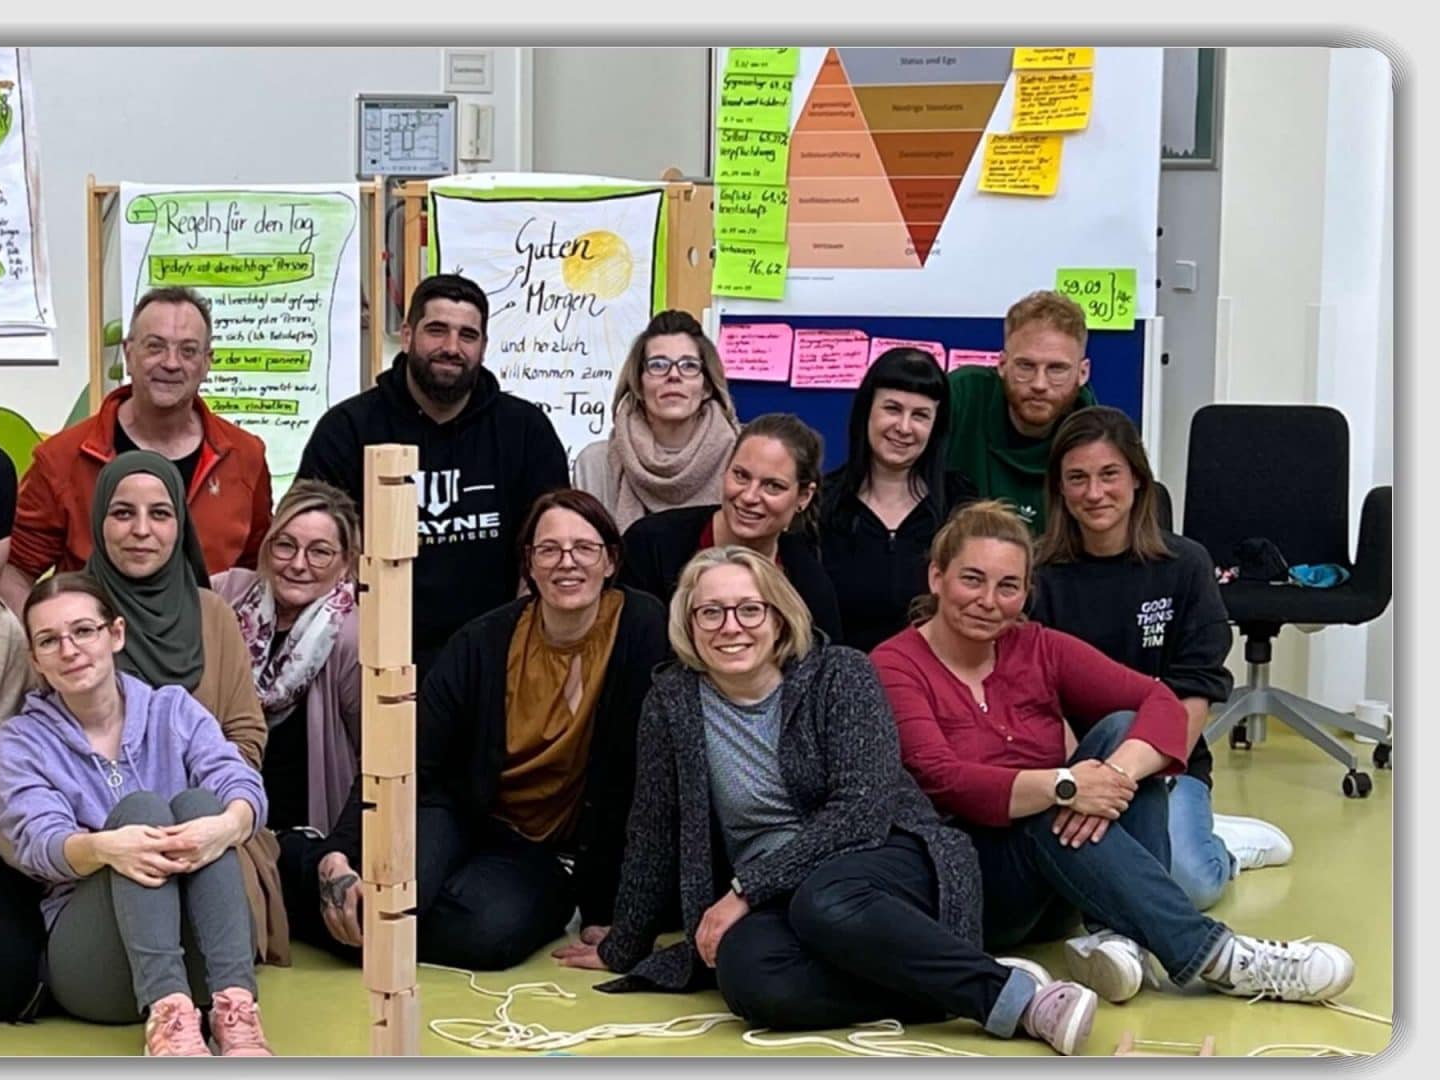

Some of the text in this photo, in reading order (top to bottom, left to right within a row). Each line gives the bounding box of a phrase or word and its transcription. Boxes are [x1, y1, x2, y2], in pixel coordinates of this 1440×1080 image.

[160, 200, 319, 254] Regeln für den Tag
[515, 217, 595, 288] Guten
[526, 280, 607, 333] Morgen
[501, 337, 526, 353] und
[534, 336, 589, 356] herzlich
[417, 512, 501, 535] AYNE
